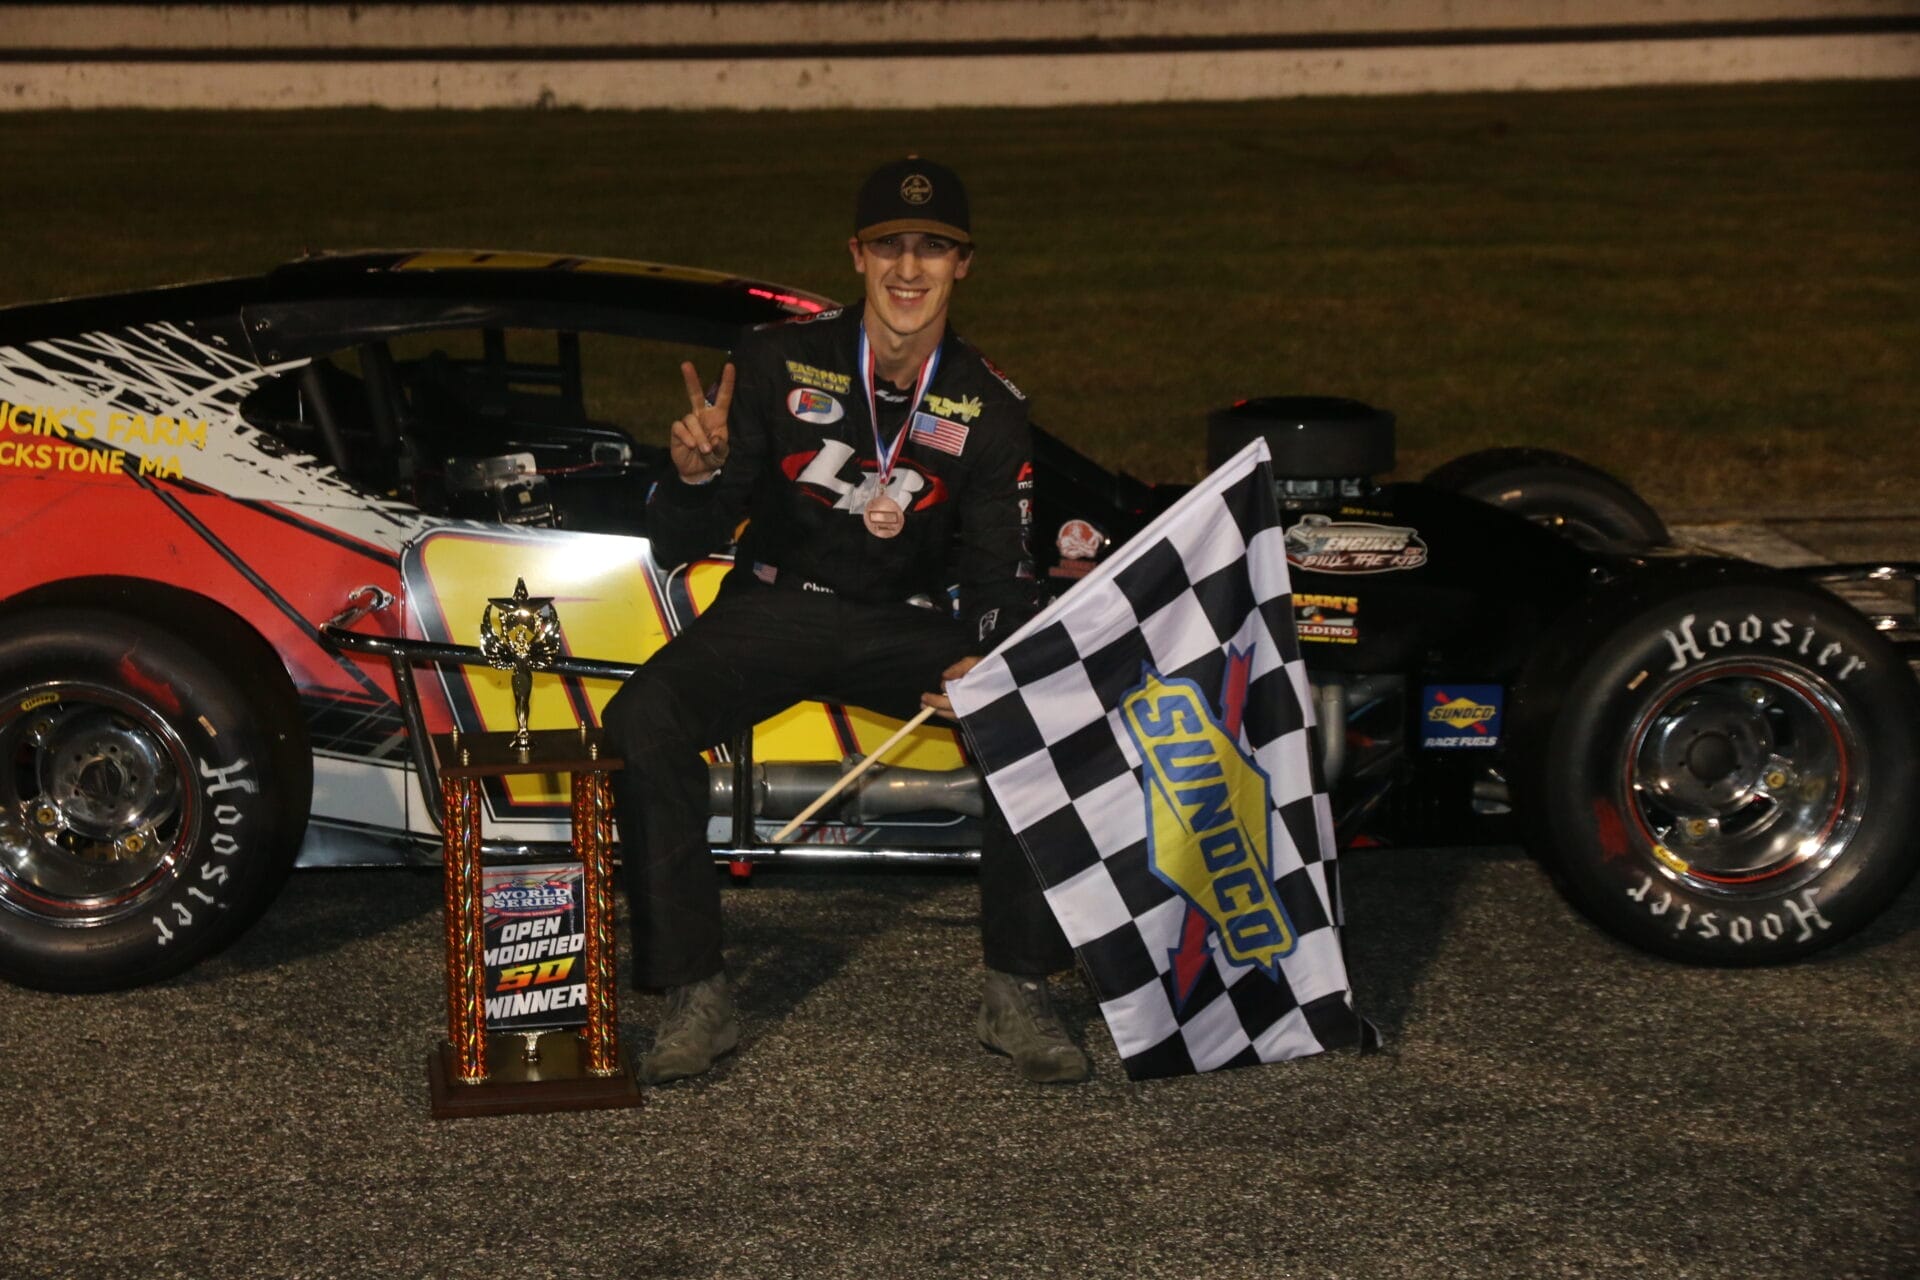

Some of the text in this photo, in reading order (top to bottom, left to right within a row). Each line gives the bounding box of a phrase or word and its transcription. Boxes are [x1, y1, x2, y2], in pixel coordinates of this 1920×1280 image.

[107, 412, 207, 449] FARM
[138, 453, 183, 480] MA
[1323, 537, 1409, 552] ENGINES
[1302, 554, 1349, 568] BILLY
[1662, 613, 1867, 681] Hoosier
[1430, 707, 1495, 720] SUNOCO
[1424, 736, 1498, 747] RACE FUELS
[1130, 694, 1284, 953] SUNOCO
[153, 757, 259, 946] Hoosier
[491, 888, 572, 900] WORLD
[494, 896, 567, 909] SERIES
[1626, 877, 1833, 944] Hoosier
[501, 916, 561, 943] OPEN
[484, 933, 585, 967] MODIFIED
[495, 957, 576, 992] 50
[486, 983, 588, 1019] WINNER
